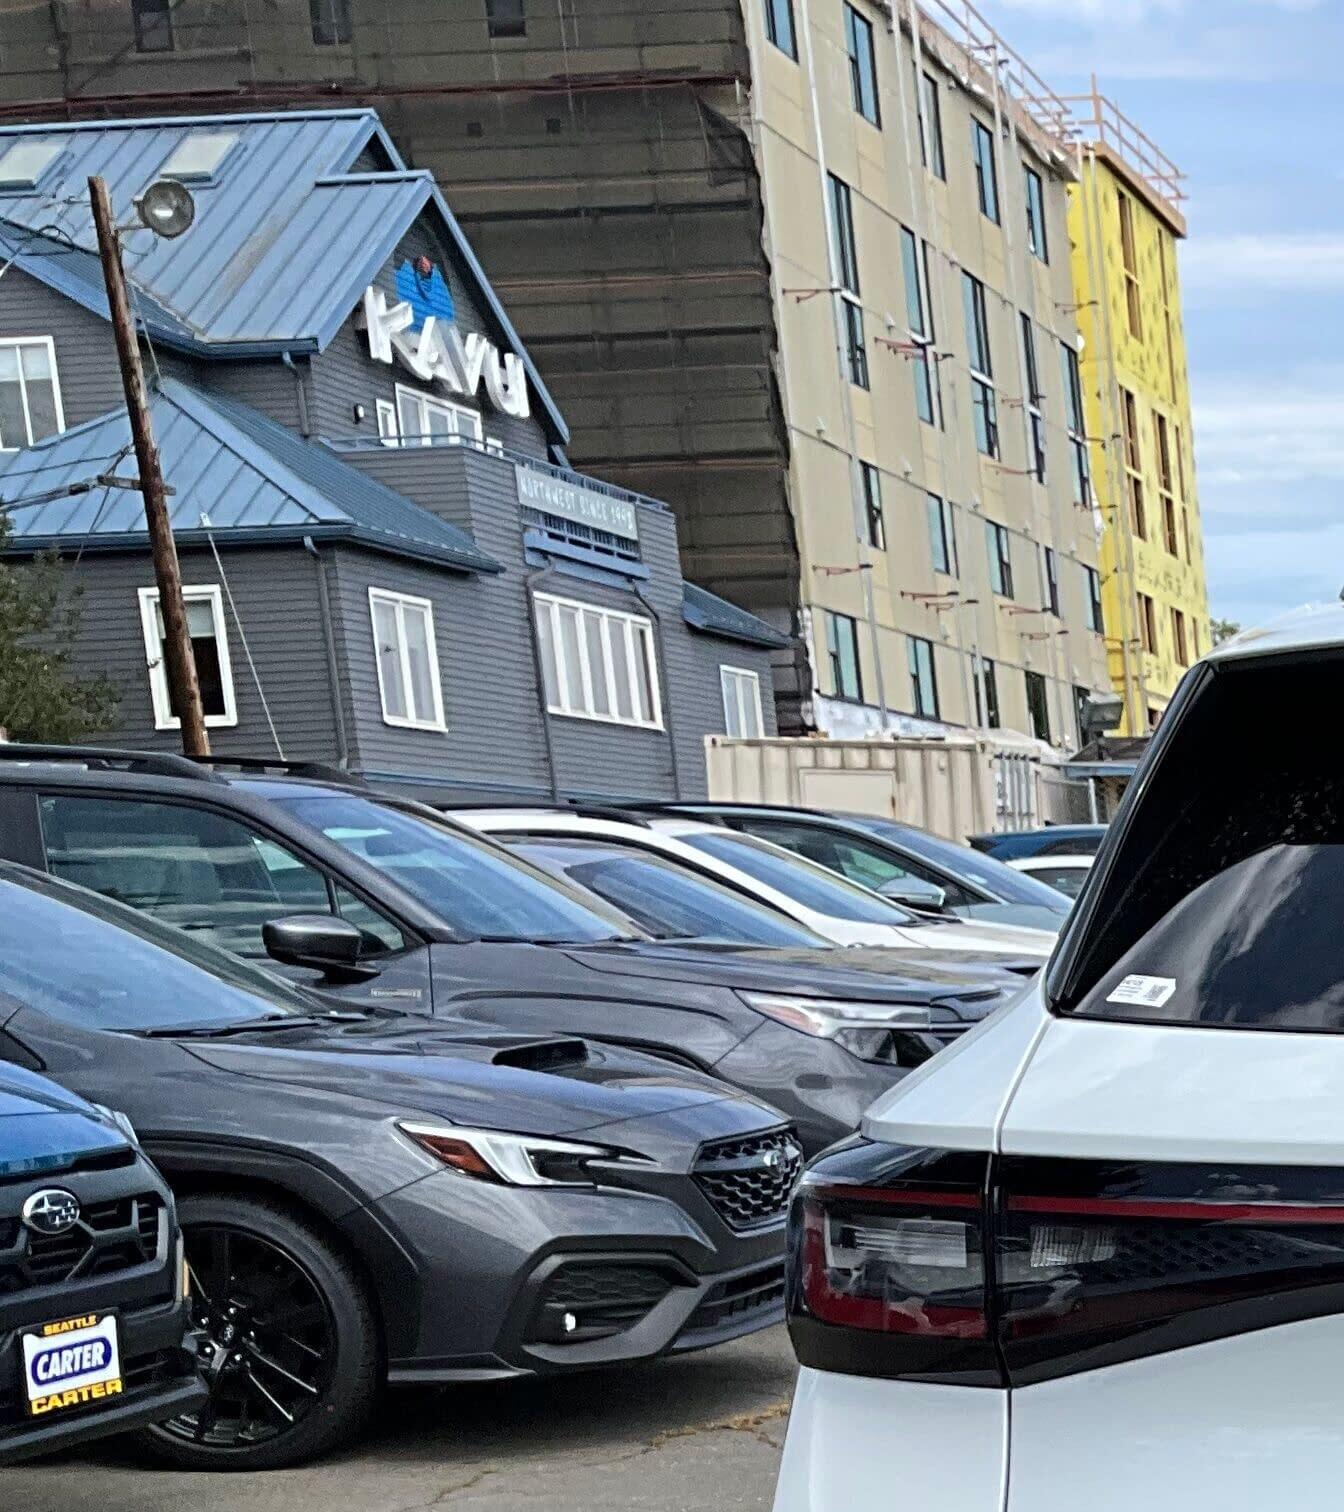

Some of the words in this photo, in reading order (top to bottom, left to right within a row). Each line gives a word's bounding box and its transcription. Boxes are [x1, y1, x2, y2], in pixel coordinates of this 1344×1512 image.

[364, 285, 530, 418] KAVU
[44, 1315, 97, 1336] SEATTLE
[36, 1341, 105, 1381] CARTER
[31, 1379, 122, 1415] CARTER
